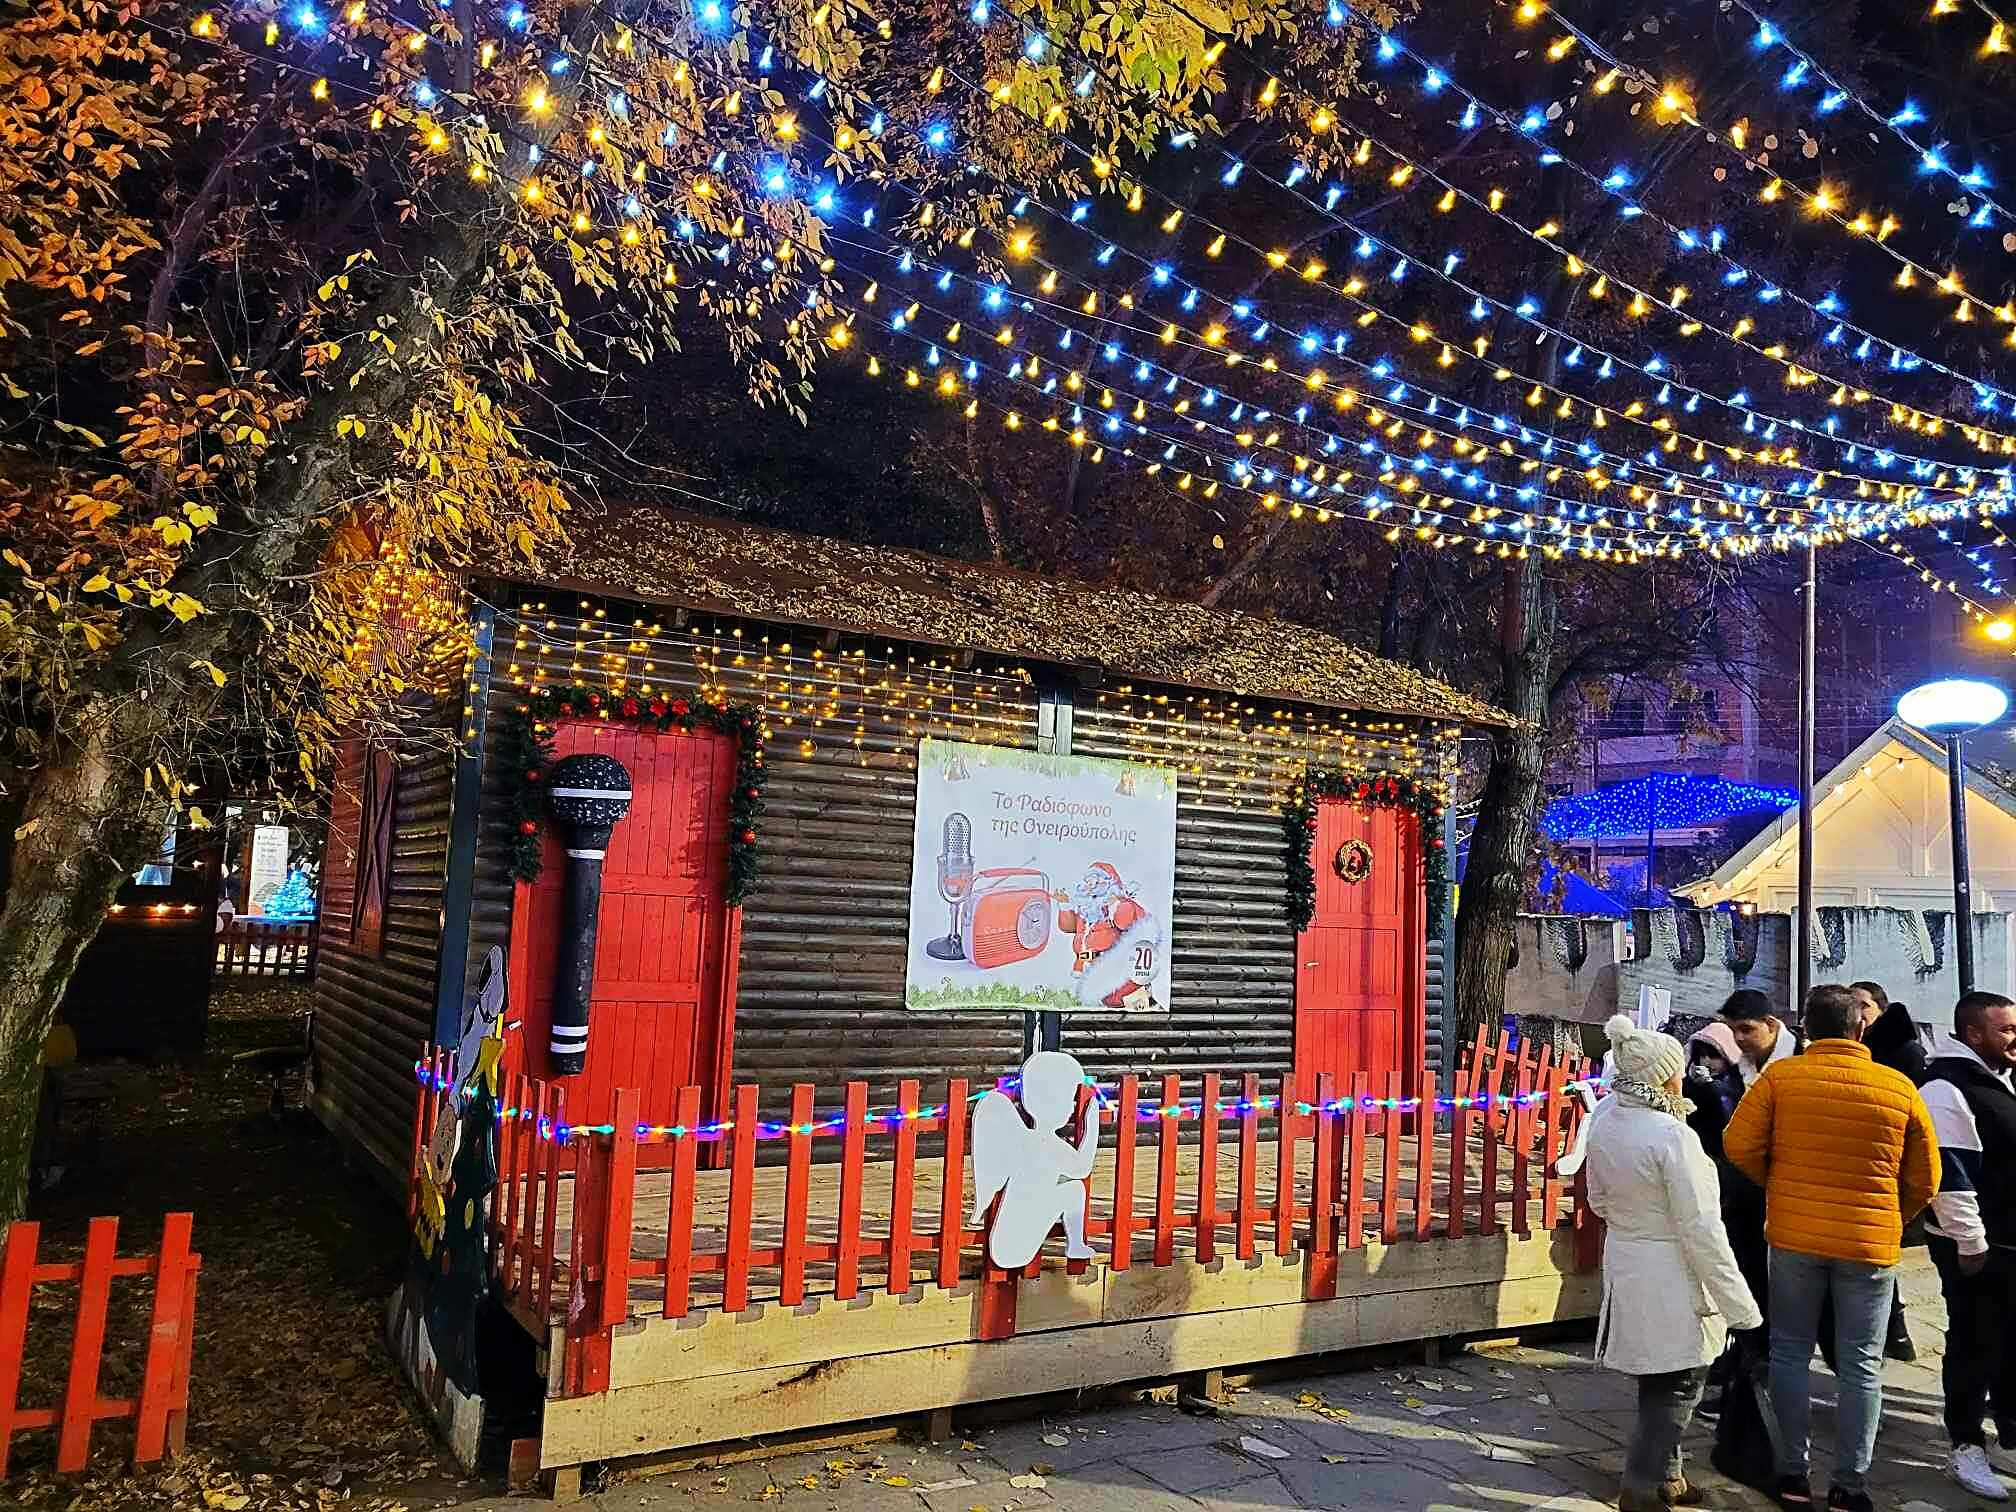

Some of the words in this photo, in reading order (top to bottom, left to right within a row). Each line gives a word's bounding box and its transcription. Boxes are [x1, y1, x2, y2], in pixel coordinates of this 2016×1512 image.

[992, 791, 1013, 809] Το
[1017, 793, 1112, 819] Ραδιόφωνο
[992, 819, 1018, 837] της
[1023, 817, 1137, 846] Ονειρούπολης
[1135, 947, 1152, 970] 20
